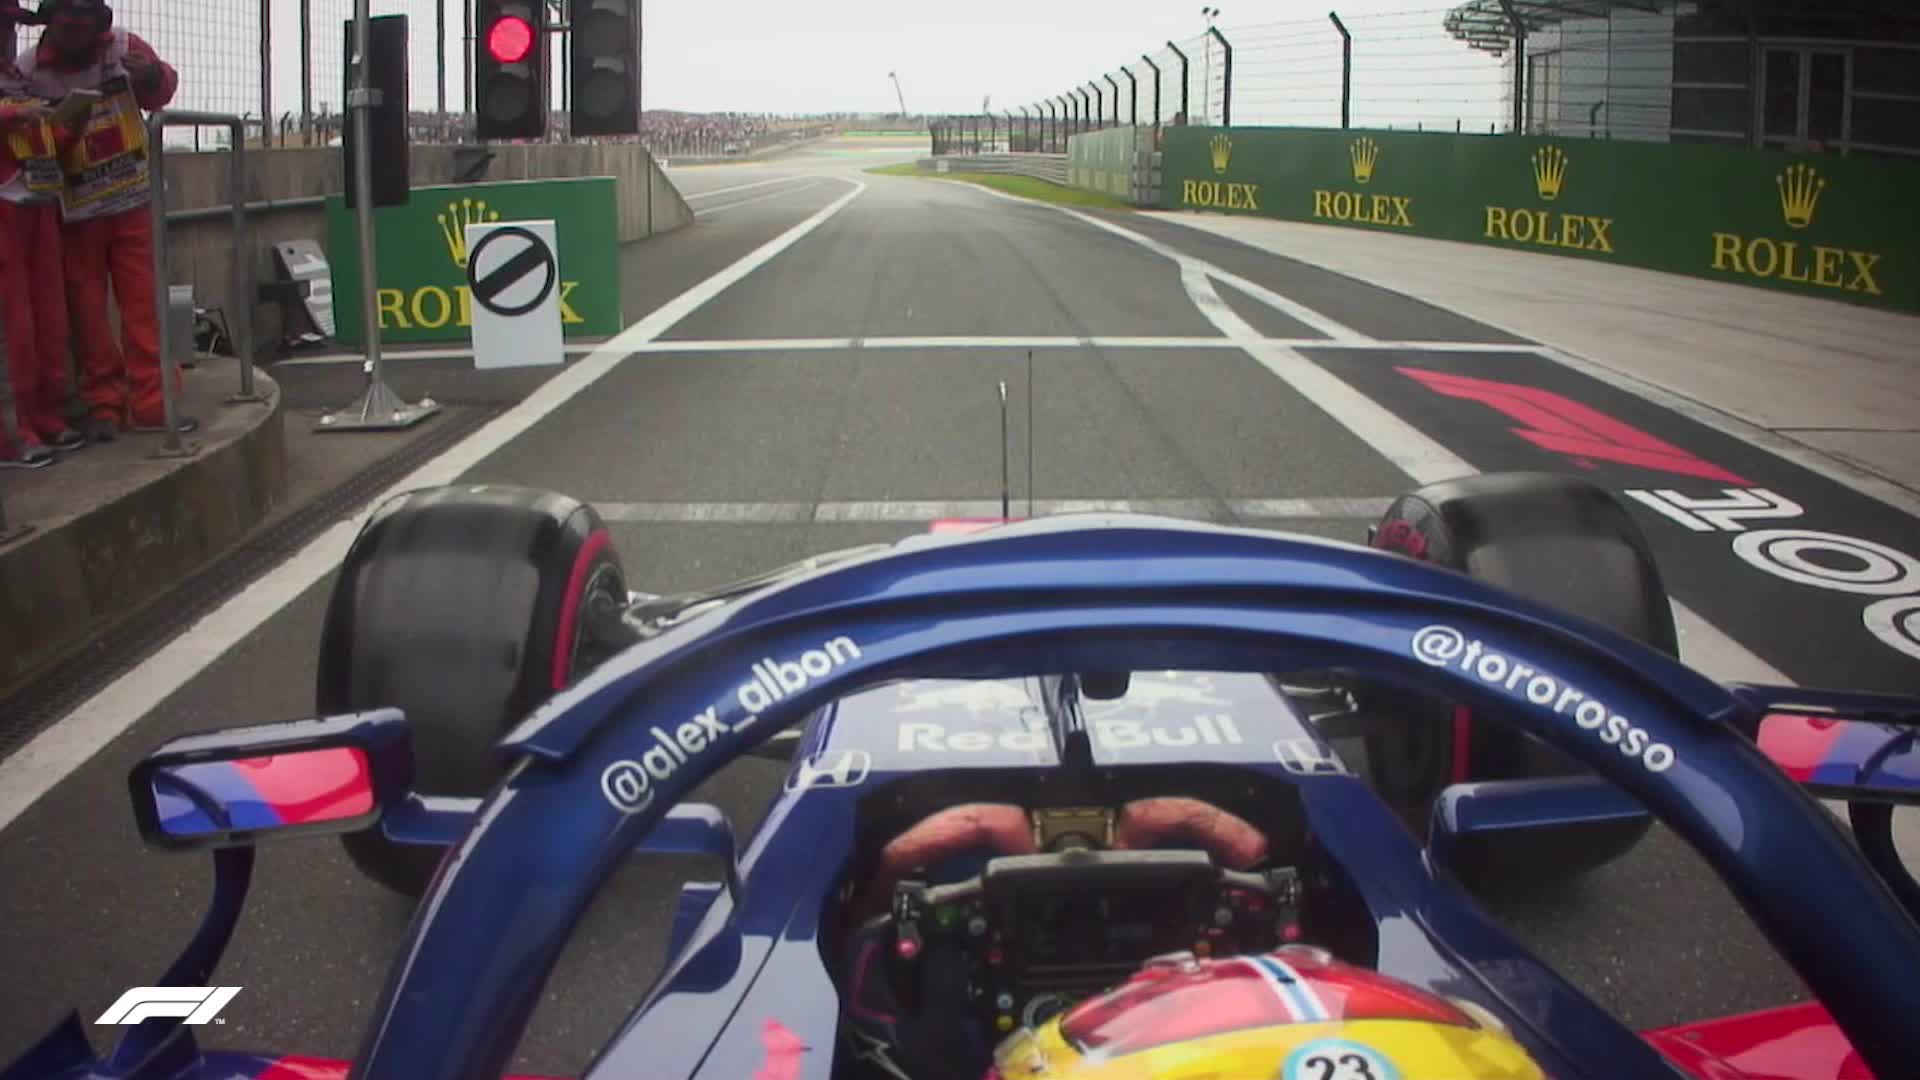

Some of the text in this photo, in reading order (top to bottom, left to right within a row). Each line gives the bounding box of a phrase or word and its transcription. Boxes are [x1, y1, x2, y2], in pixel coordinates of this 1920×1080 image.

[1183, 179, 1260, 210] ROLEX
[1312, 189, 1414, 227] ROLEX
[1484, 205, 1615, 254] ROLEX
[1711, 231, 1883, 295] ROLEX
[1411, 624, 1676, 773] @tororosso
[600, 635, 862, 814] @alex_albon
[897, 713, 1244, 752] Red Bull
[1305, 1053, 1377, 1080] 23
